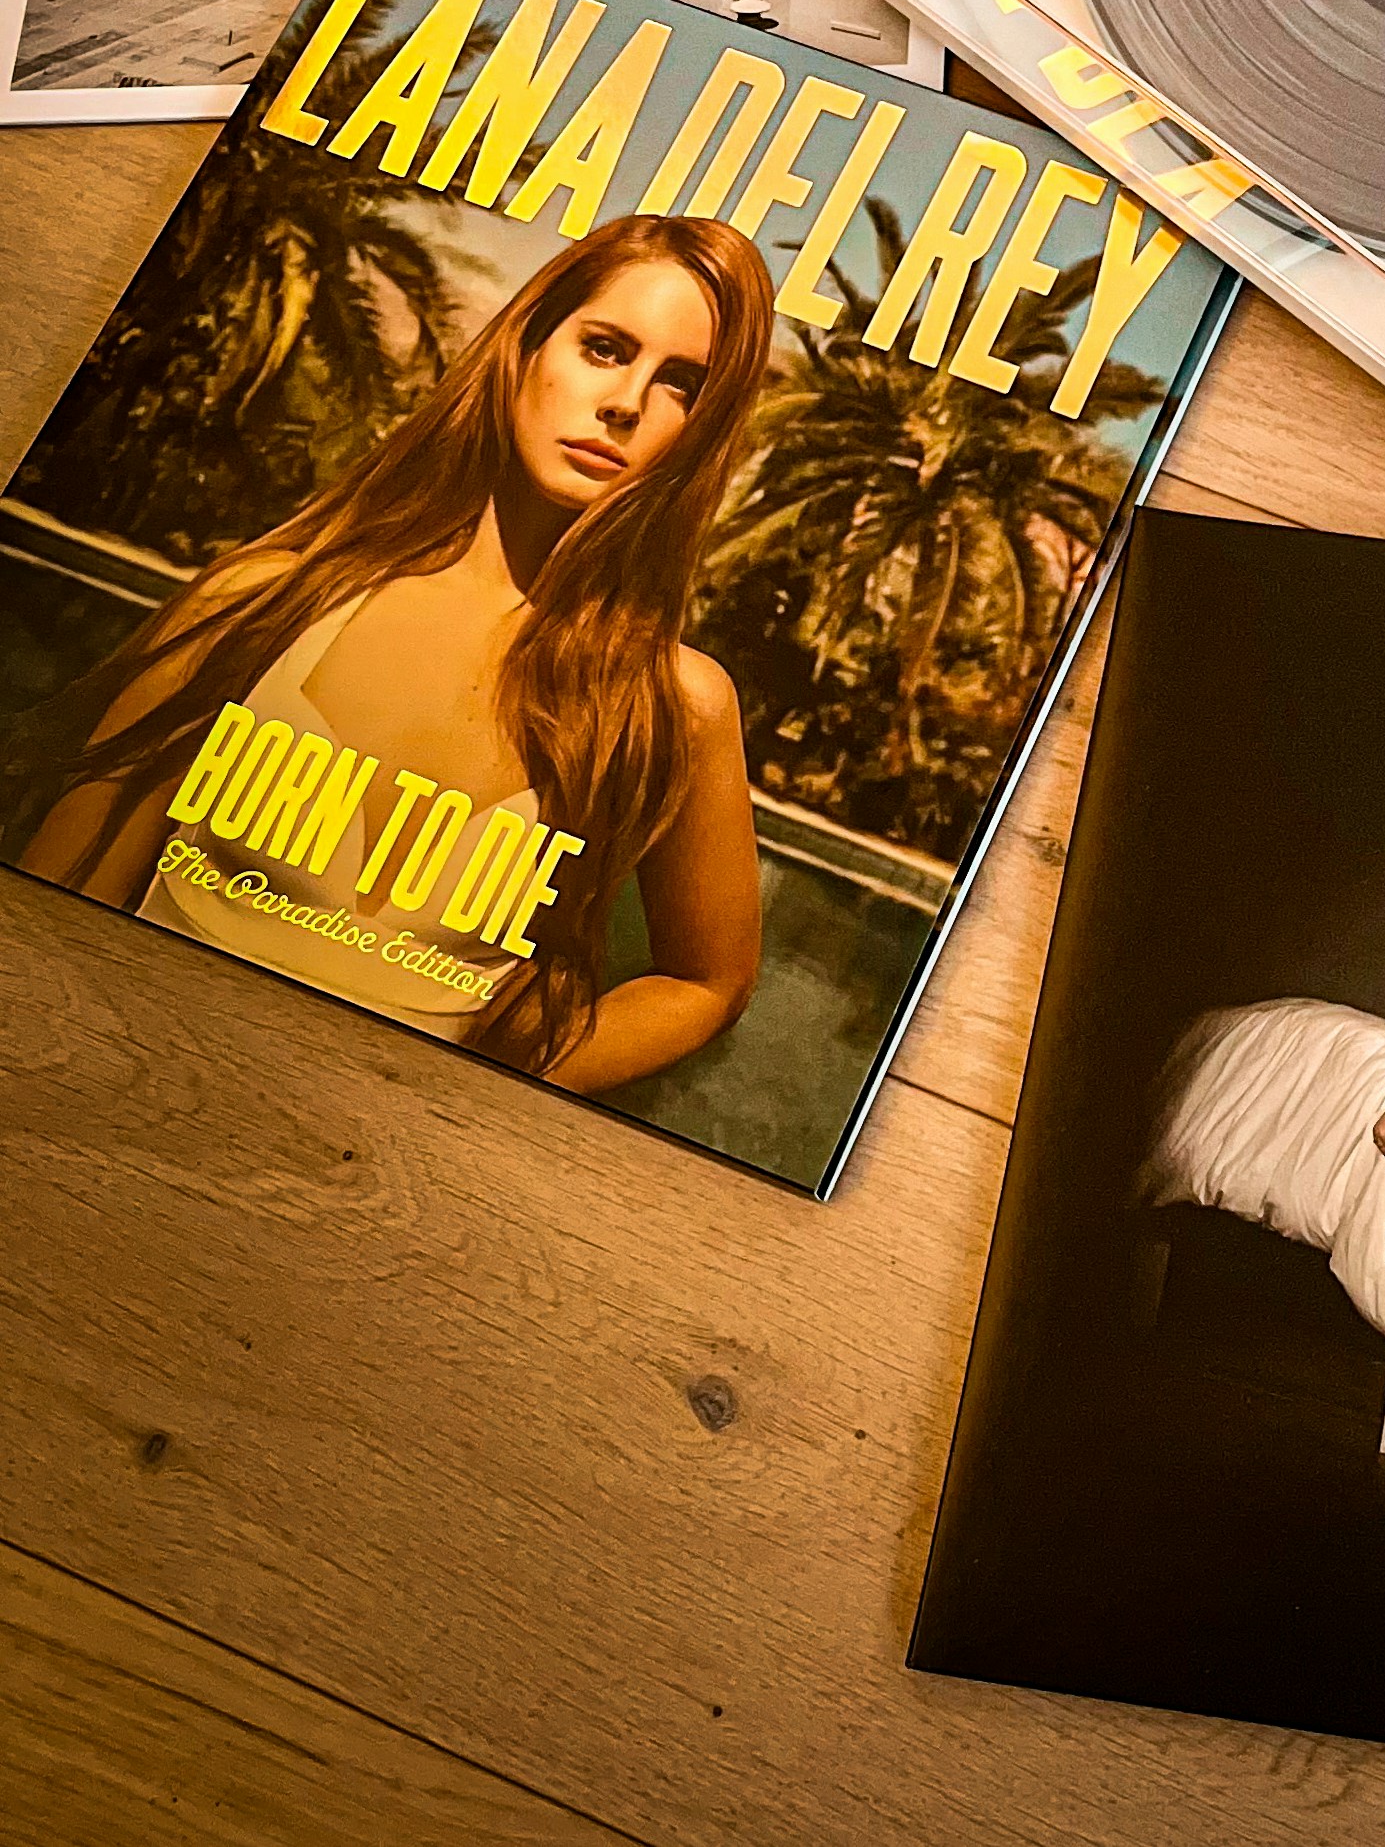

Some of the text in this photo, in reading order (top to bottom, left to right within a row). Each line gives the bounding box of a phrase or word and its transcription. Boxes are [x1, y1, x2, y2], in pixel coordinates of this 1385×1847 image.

[636, 46, 907, 330] DEL
[861, 131, 1186, 420] REY
[157, 838, 495, 1001] The Paradise Edition
[166, 701, 586, 959] BORN TO DIE
